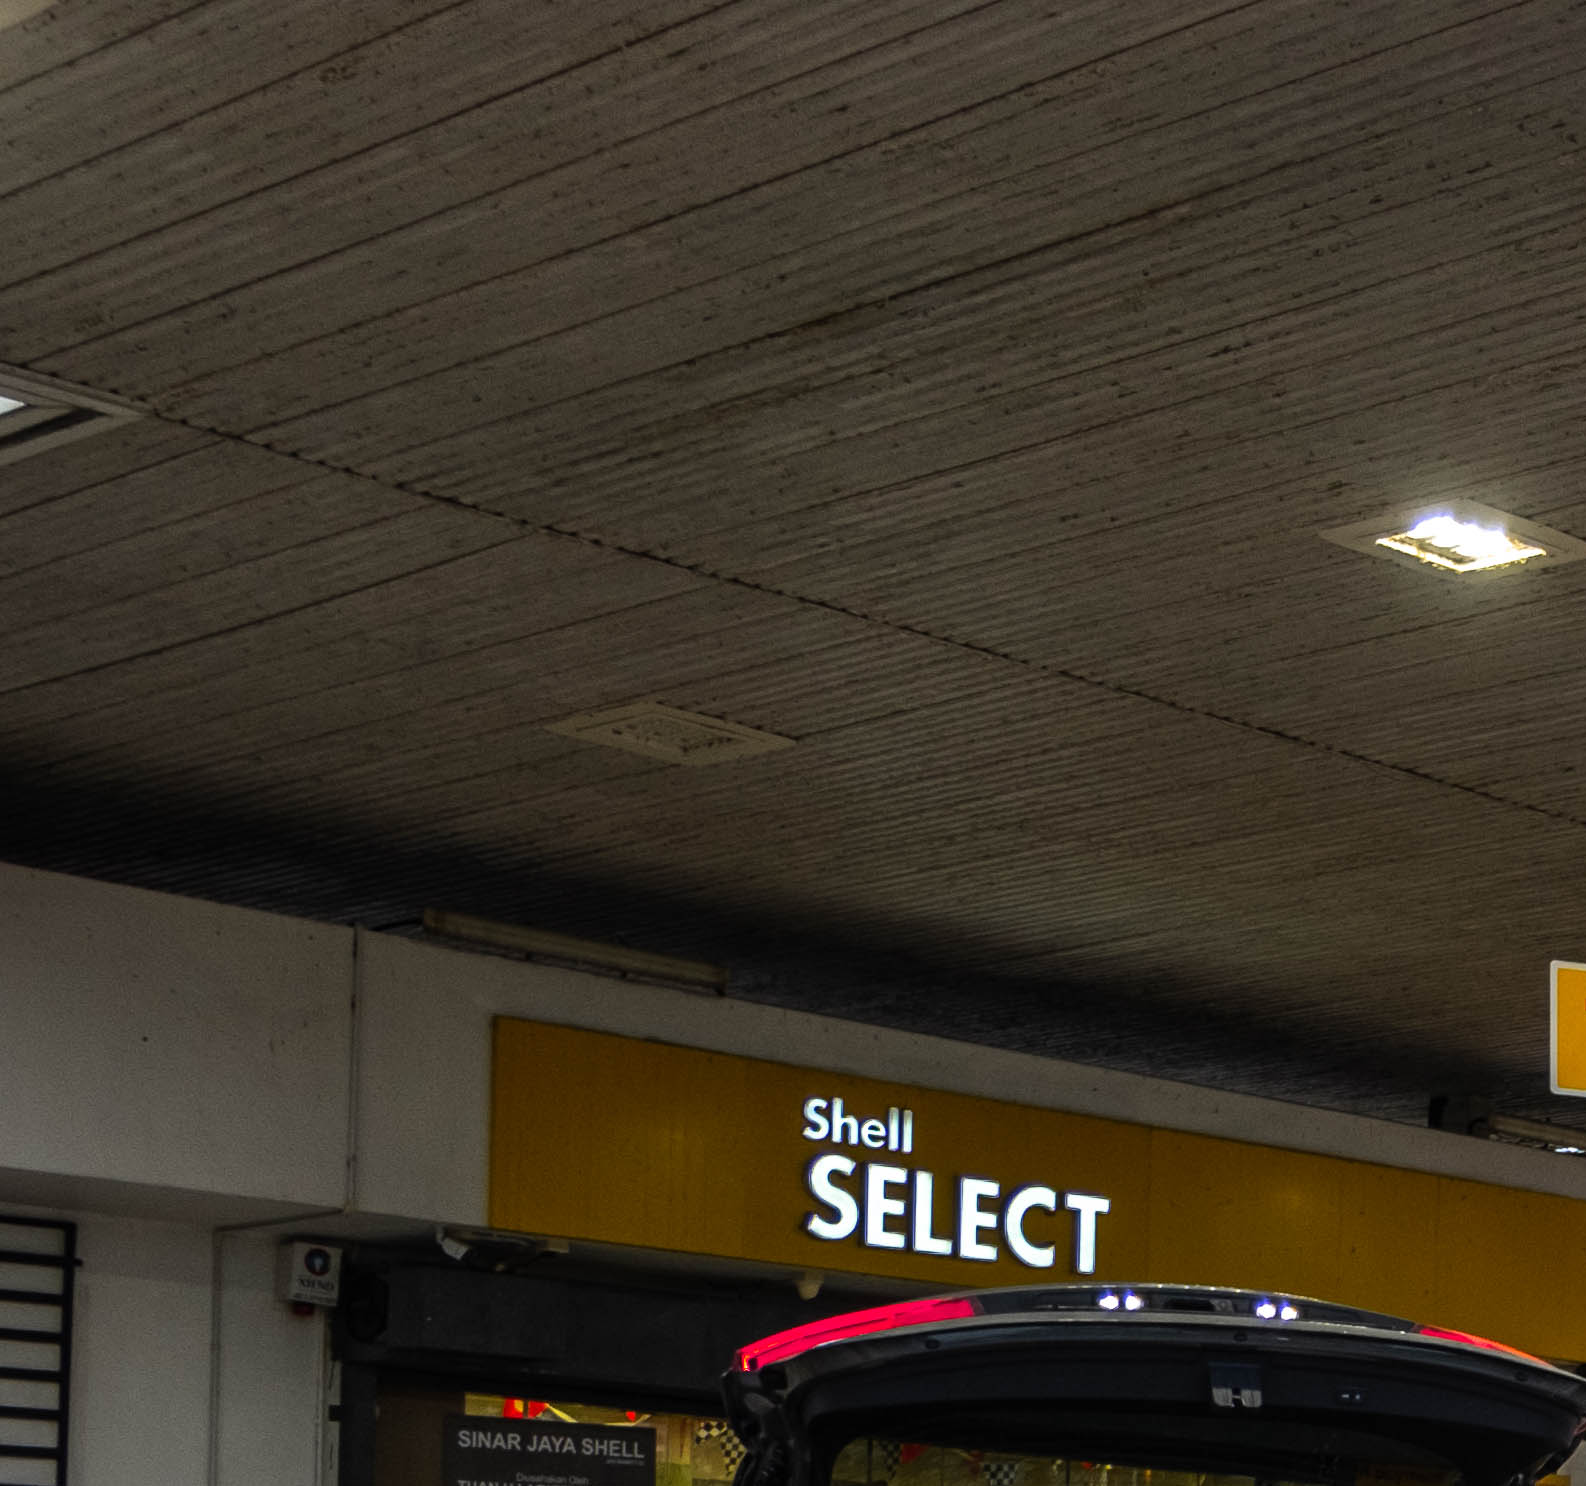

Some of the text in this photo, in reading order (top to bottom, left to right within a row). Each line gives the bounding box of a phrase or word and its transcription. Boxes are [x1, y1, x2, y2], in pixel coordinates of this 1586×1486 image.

[803, 1098, 913, 1153] Shell
[806, 1154, 1110, 1275] SELECT
[458, 1430, 645, 1459] SINAR JAYA SHELL
